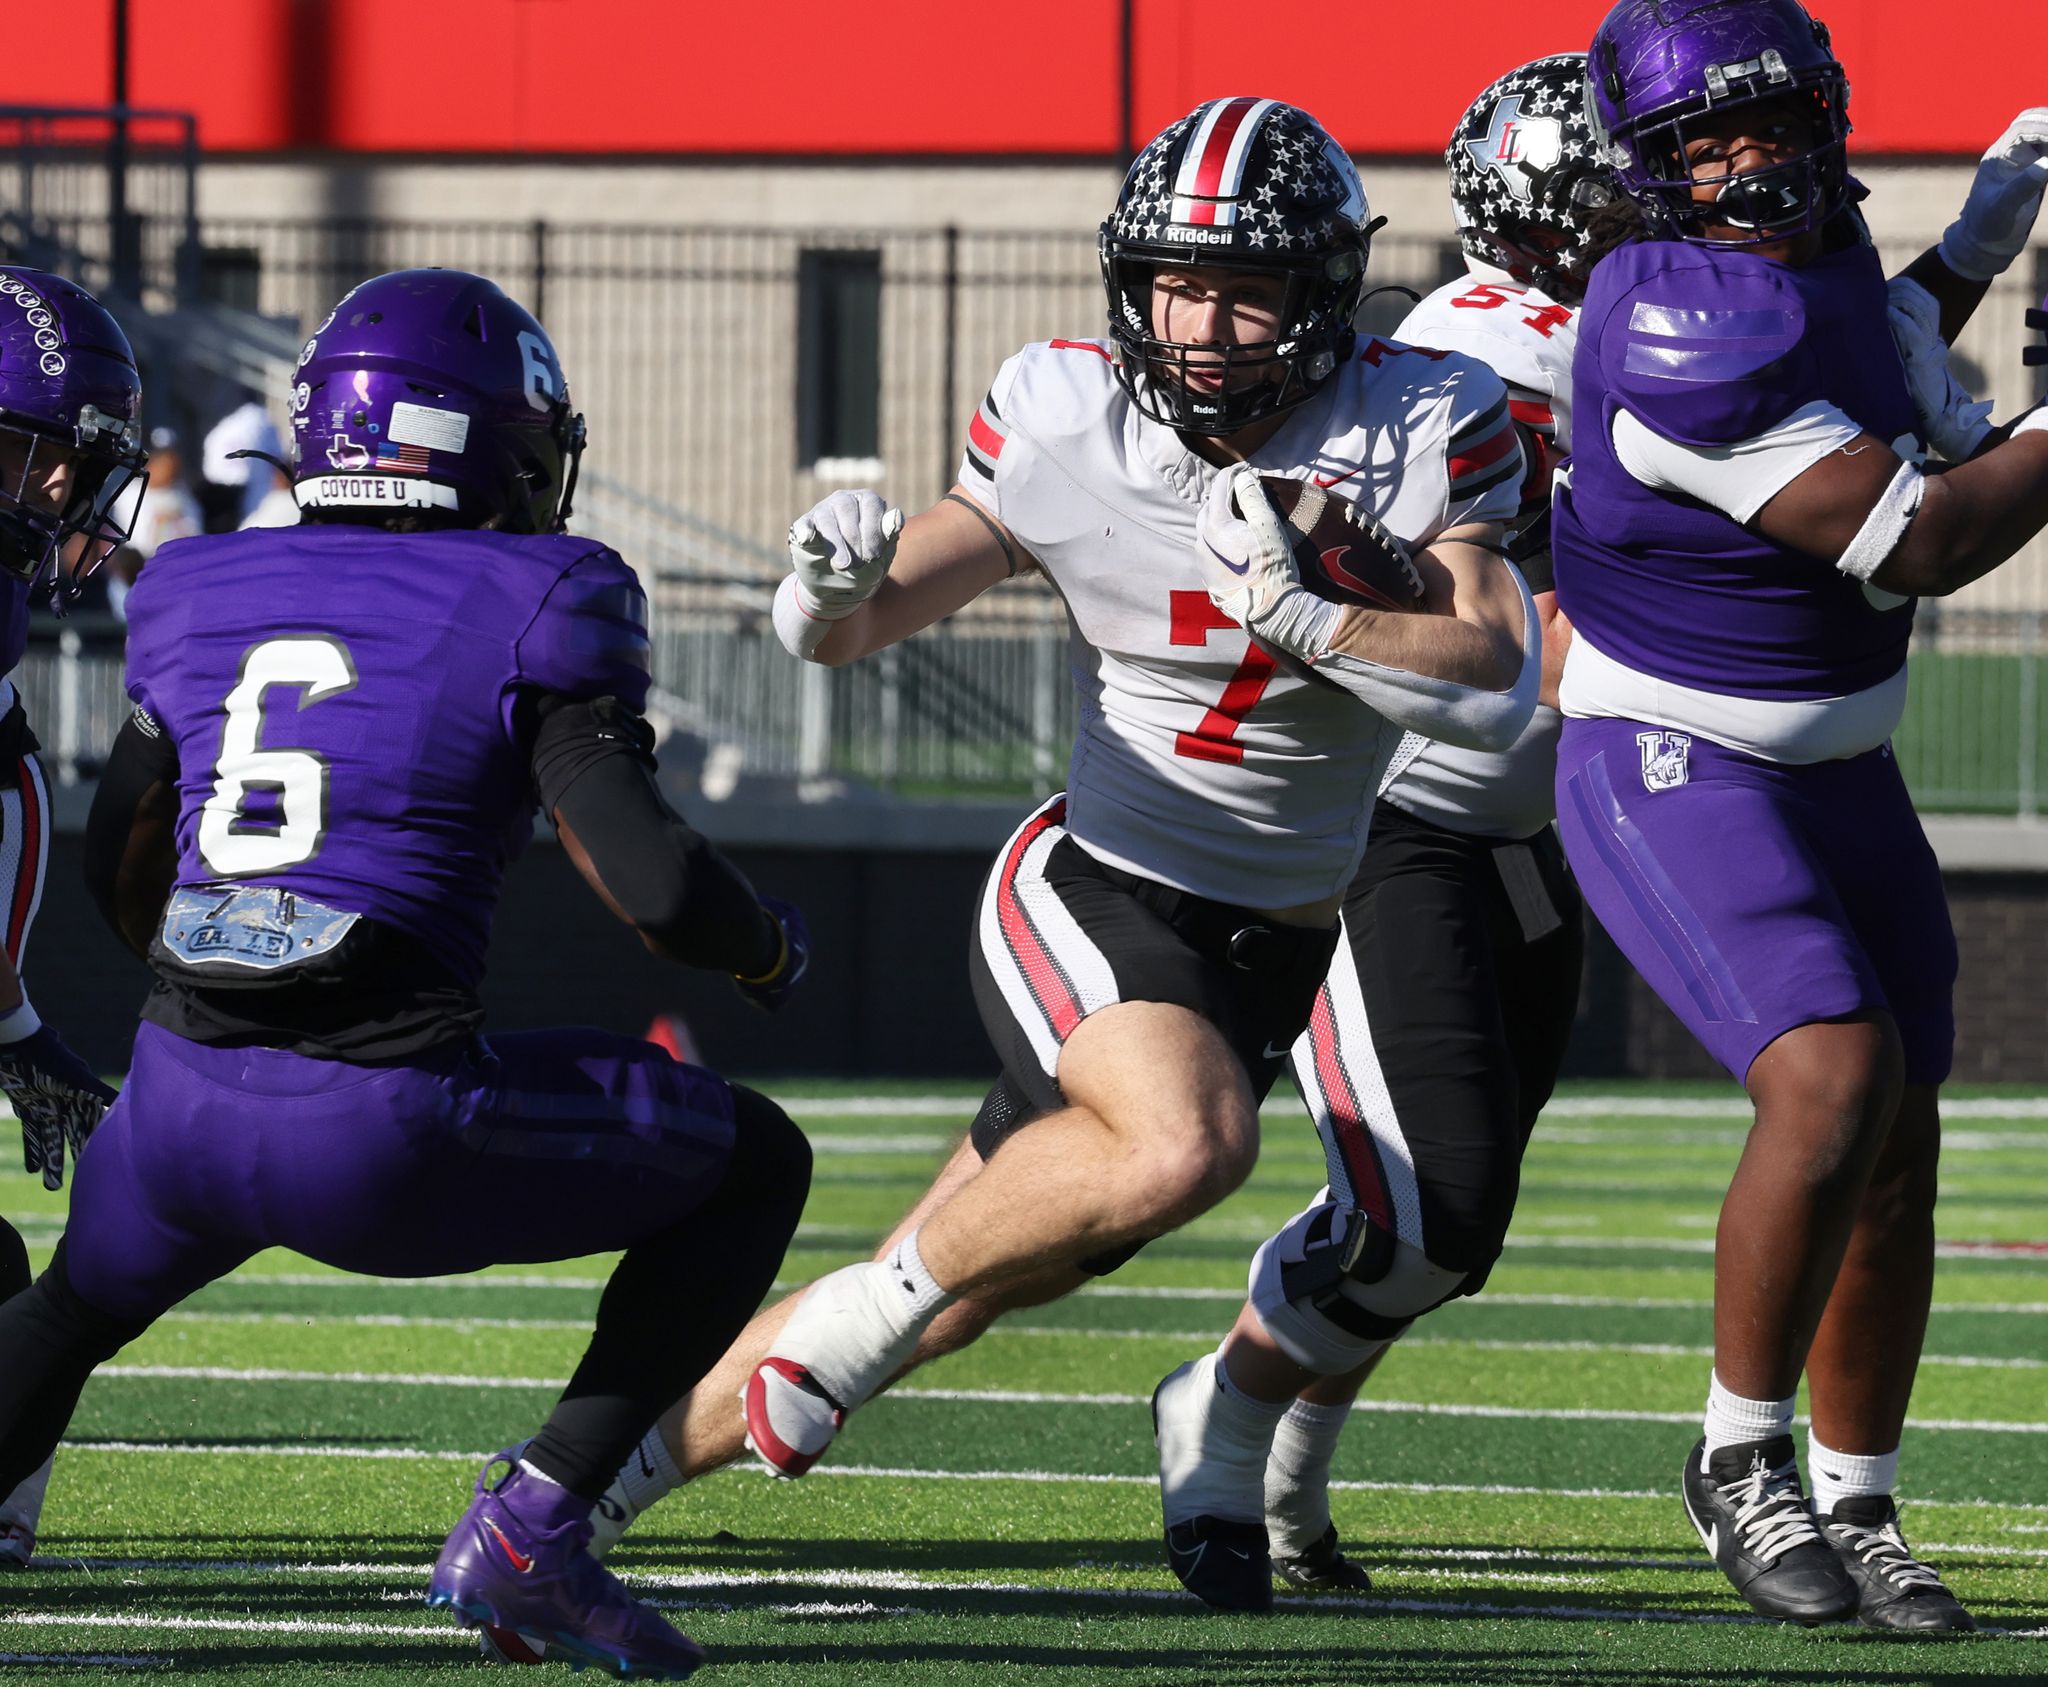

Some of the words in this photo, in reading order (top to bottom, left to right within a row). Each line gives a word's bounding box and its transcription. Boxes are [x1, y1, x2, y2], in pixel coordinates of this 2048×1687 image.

[1167, 227, 1233, 245] Riddell
[1450, 284, 1573, 340] 54
[516, 330, 554, 413] 6
[321, 480, 386, 498] COYOTE
[393, 481, 405, 499] U
[1169, 590, 1279, 765] 7
[197, 634, 358, 878] 6
